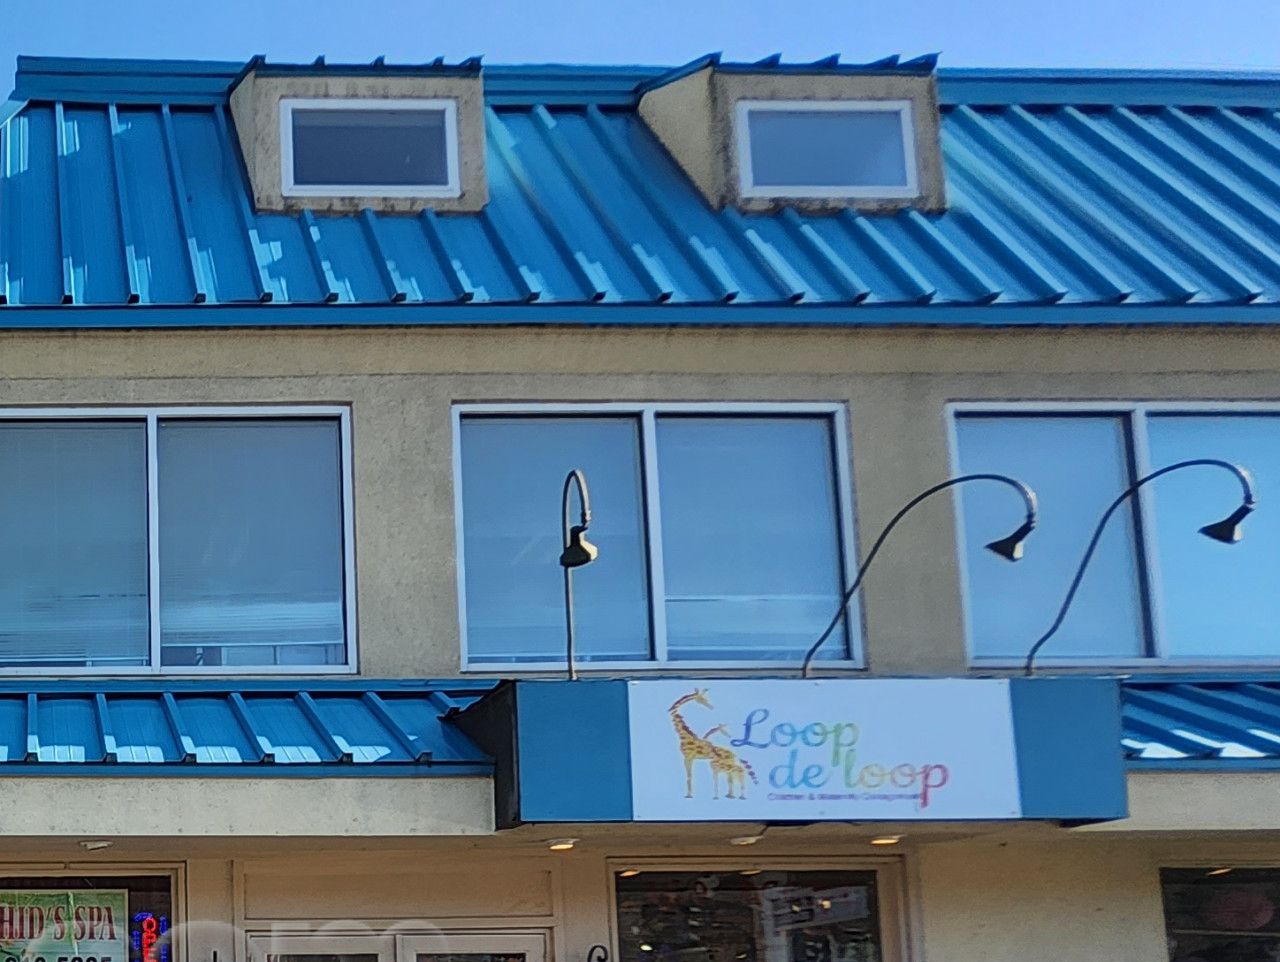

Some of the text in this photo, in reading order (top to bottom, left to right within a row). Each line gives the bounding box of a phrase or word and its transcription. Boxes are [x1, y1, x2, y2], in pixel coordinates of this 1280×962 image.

[730, 708, 860, 768] Loop
[769, 749, 949, 809] de loop
[73, 905, 117, 941] SPA
